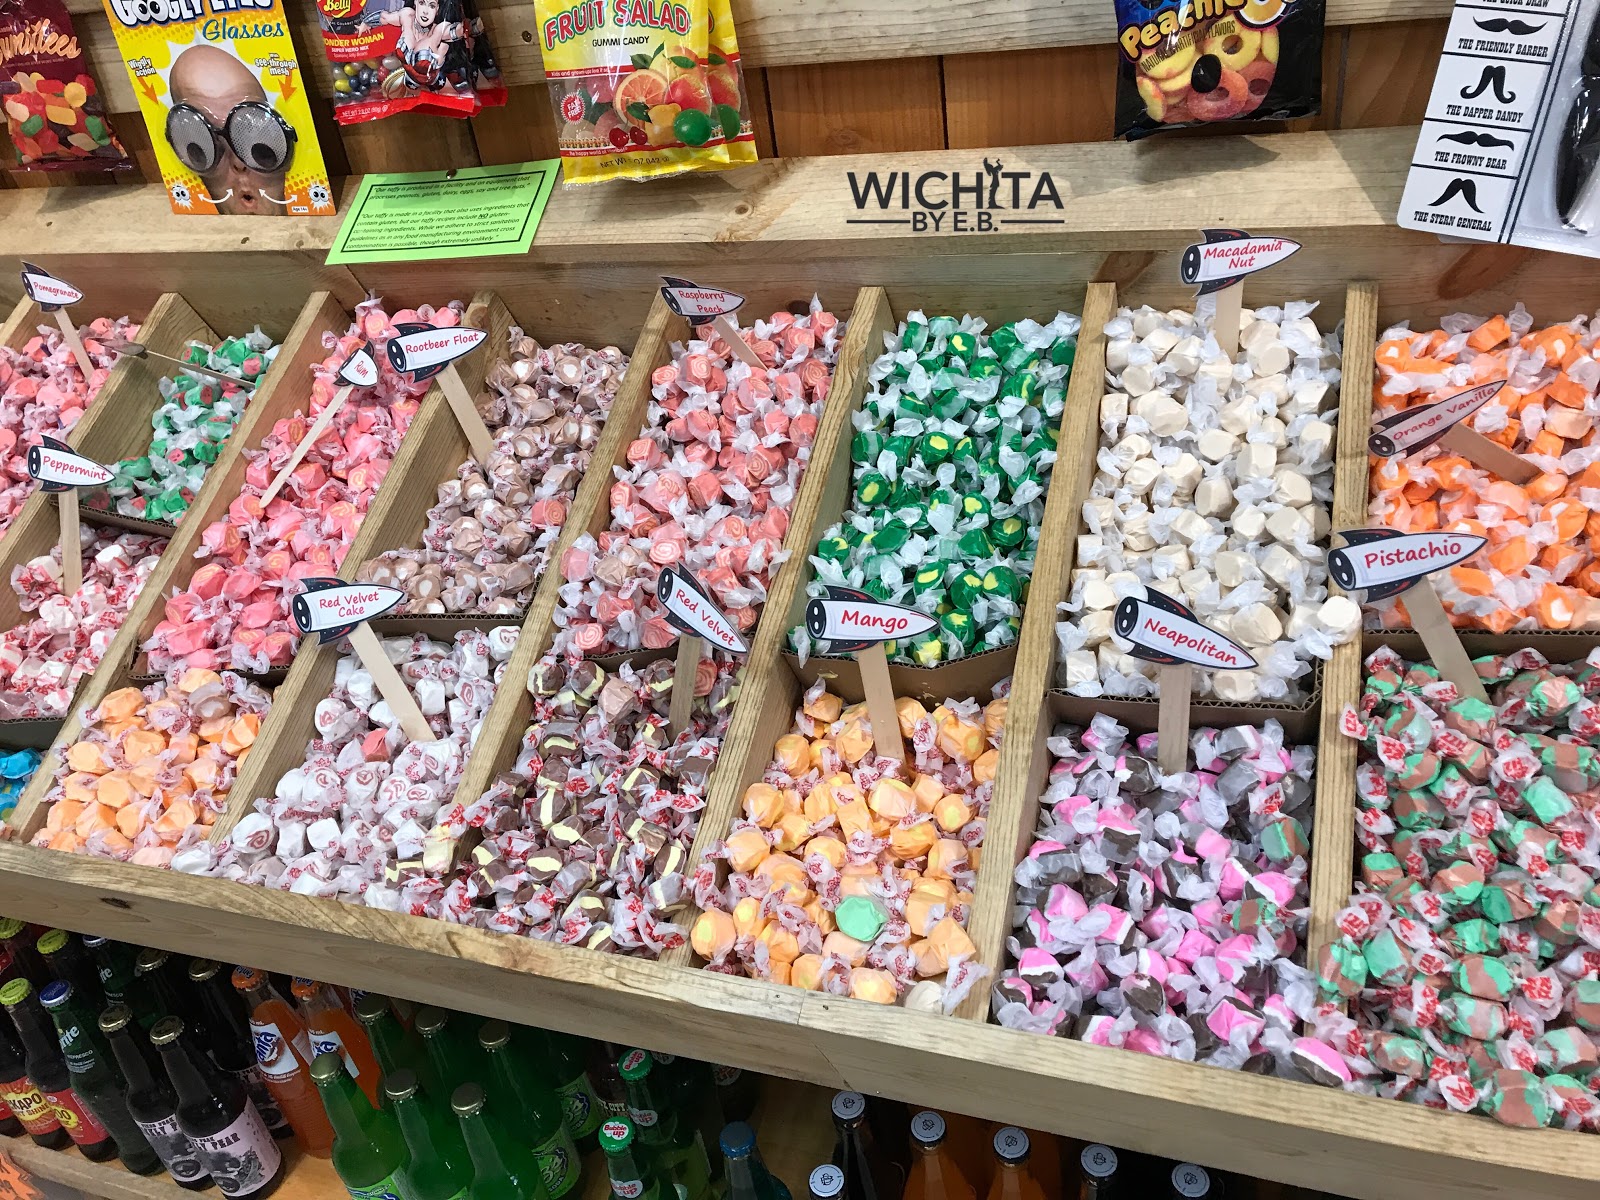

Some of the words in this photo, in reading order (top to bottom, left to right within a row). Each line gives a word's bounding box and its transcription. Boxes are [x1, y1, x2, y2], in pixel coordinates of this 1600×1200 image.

[323, 0, 351, 18] Belly
[202, 18, 284, 40] Glasses
[545, 0, 607, 49] FRUIT
[614, 0, 690, 34] SALAD
[1208, 20, 1236, 38] FLAVORS
[351, 32, 385, 46] WOMAN
[592, 38, 620, 47] GUMMI
[623, 36, 650, 46] CANDY
[1458, 38, 1474, 50] THE
[1475, 40, 1515, 54] FRIENDLY
[1516, 44, 1548, 58] BARBER
[128, 57, 152, 70] Wiggly
[136, 67, 156, 77] action
[254, 58, 298, 70] see-through
[269, 67, 290, 76] mesh
[1446, 104, 1461, 116] THE
[1463, 106, 1494, 120] DAPPER
[1495, 110, 1524, 123] DANDY
[600, 160, 614, 168] NET
[1434, 151, 1450, 162] THE
[1451, 153, 1485, 168] FROWNY
[1486, 157, 1507, 170] BEAR
[1413, 211, 1428, 222] THE
[1430, 213, 1456, 226] STERN
[1457, 217, 1492, 232] GENERAL
[1204, 239, 1282, 260] Macadamia
[1229, 256, 1256, 269] Nut
[34, 282, 79, 299] Pomegranate
[678, 290, 725, 302] Raspberry
[697, 304, 724, 313] Peach
[406, 339, 450, 354] Rootbeer
[454, 332, 479, 345] Float
[354, 360, 369, 378] Rum
[1394, 414, 1442, 440] Orange
[1446, 387, 1495, 414] Vanilla
[43, 456, 106, 480] Peppermint
[1364, 540, 1461, 568] Pistachio
[320, 596, 341, 608] Red
[344, 592, 379, 605] Velvet
[338, 605, 365, 617] Cake
[676, 589, 699, 613] Red
[701, 610, 735, 646] Velvet
[841, 610, 908, 634] Mango
[1144, 618, 1237, 665] Neapolitan
[256, 1032, 276, 1062] anta
[10, 1093, 42, 1110] KAPO
[28, 1103, 50, 1116] SHINE
[211, 1132, 240, 1150] PEAR
[613, 1130, 624, 1138] up
